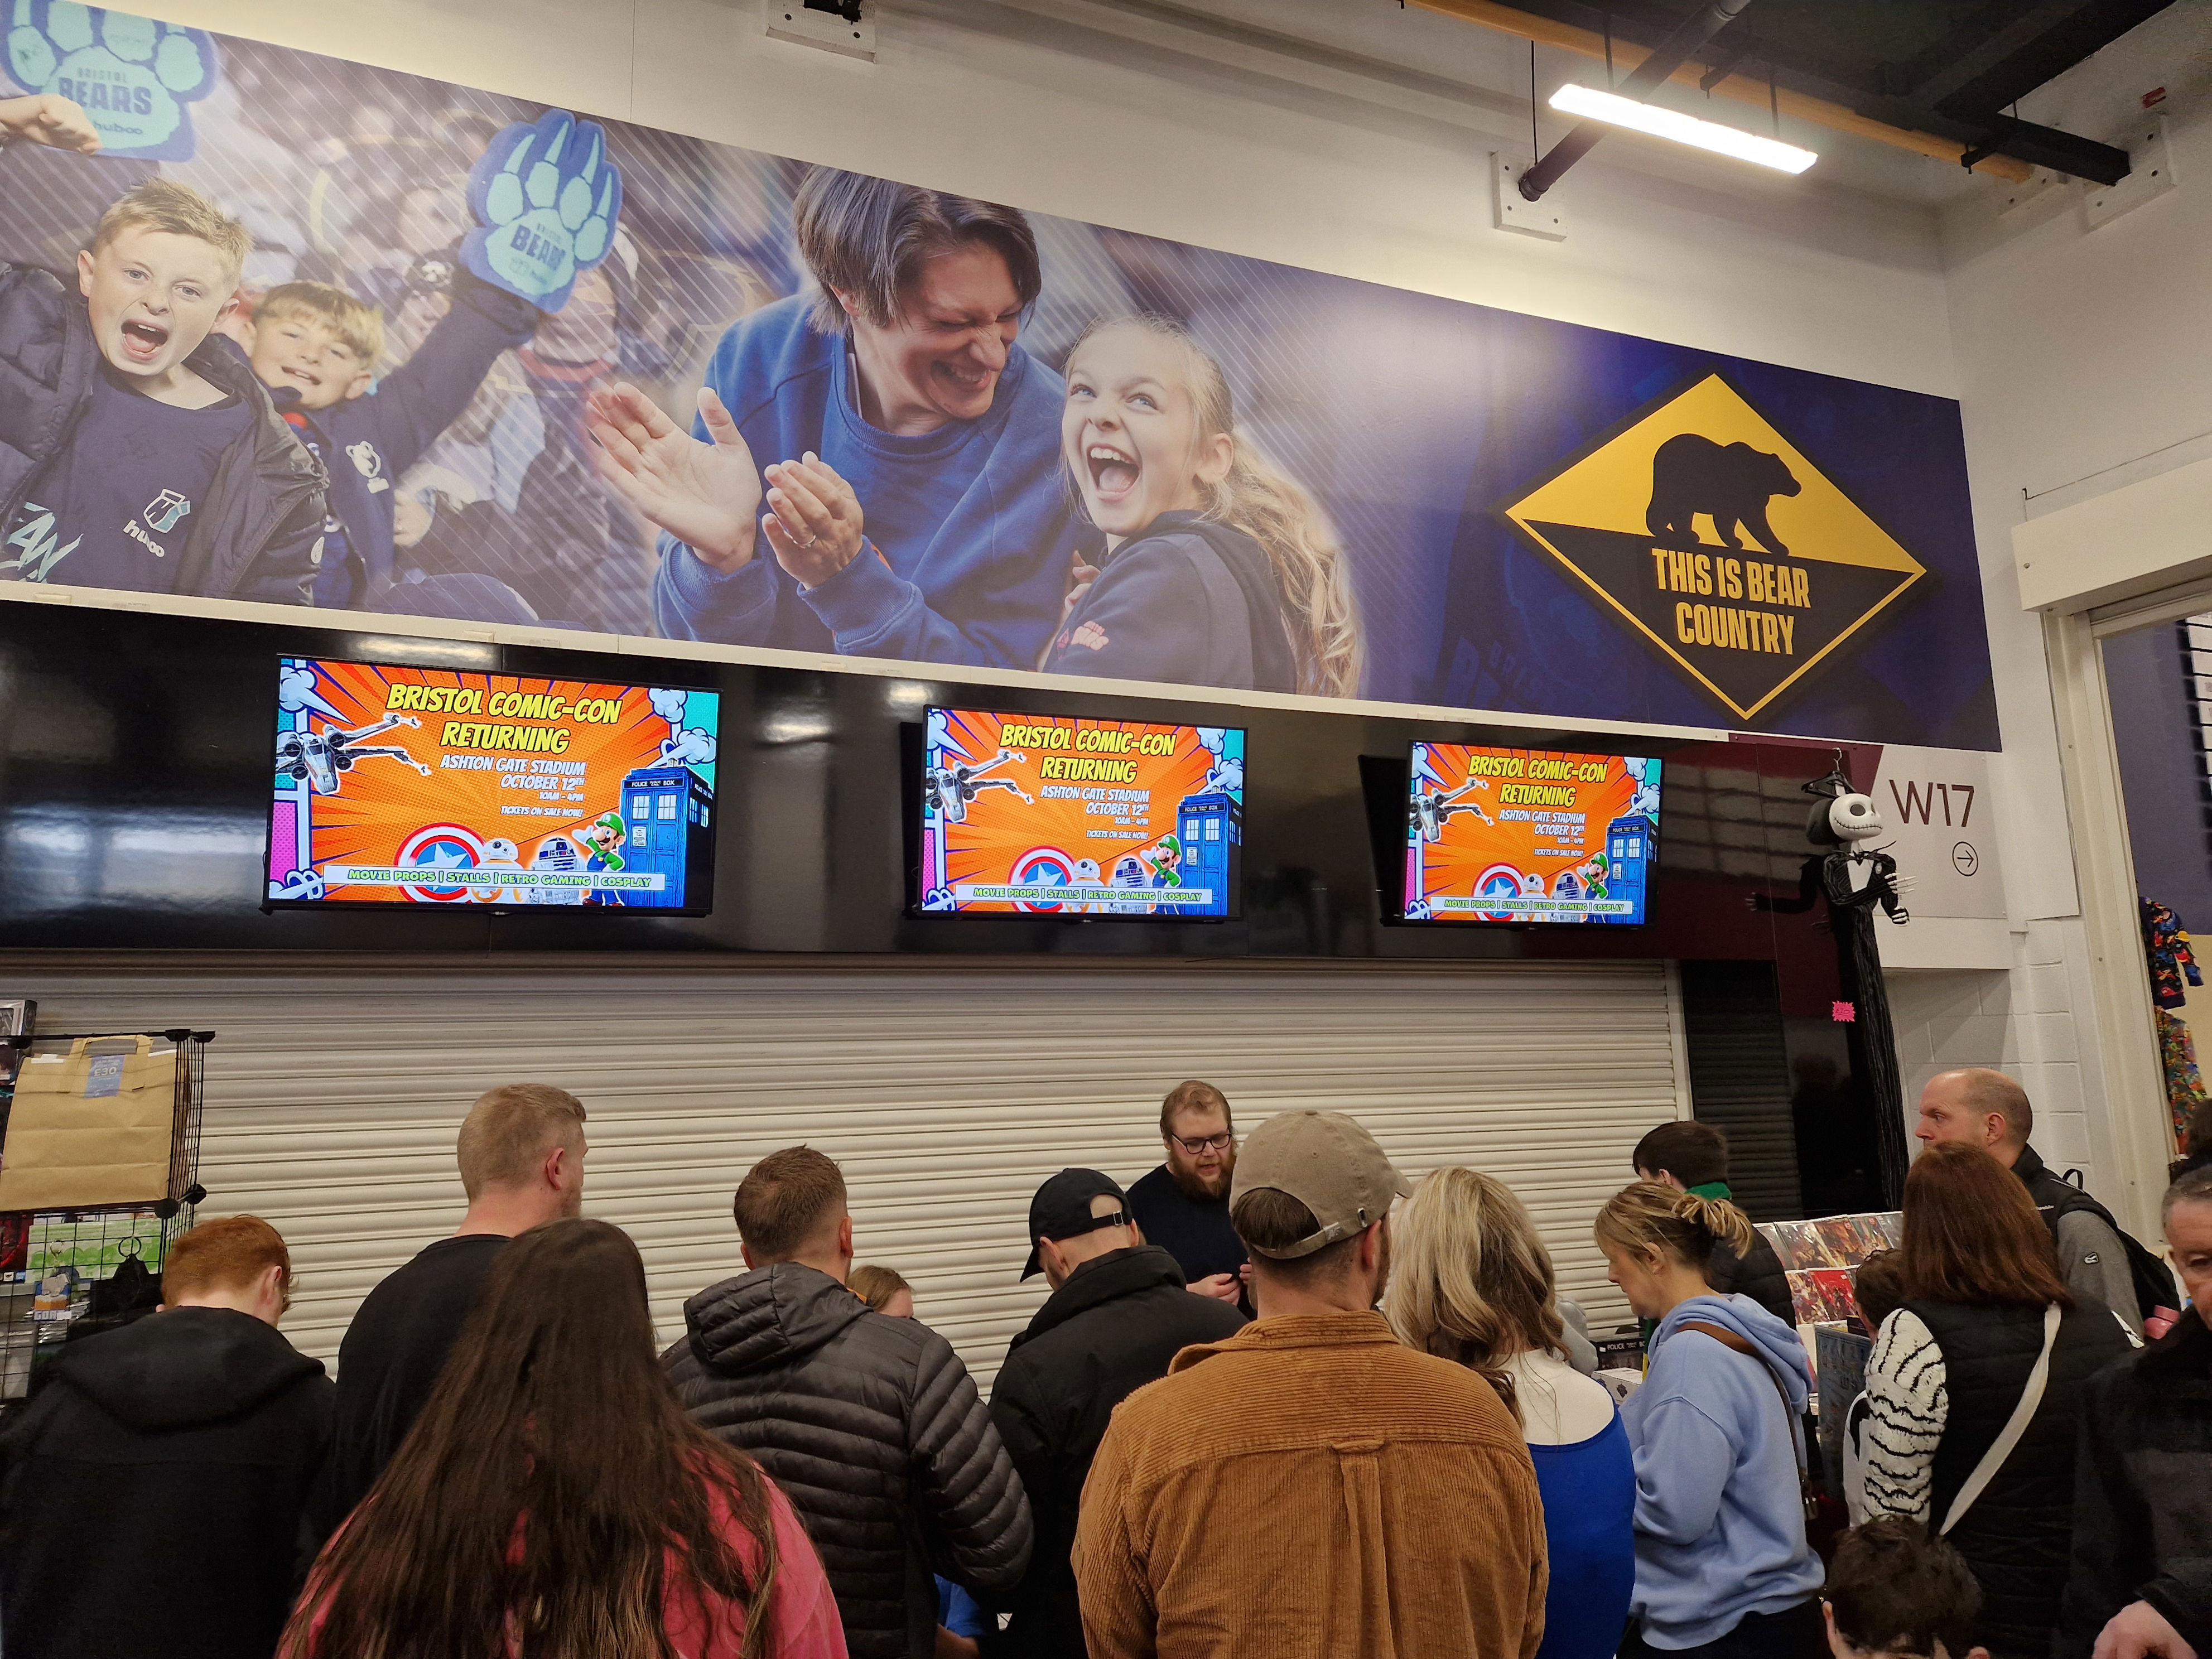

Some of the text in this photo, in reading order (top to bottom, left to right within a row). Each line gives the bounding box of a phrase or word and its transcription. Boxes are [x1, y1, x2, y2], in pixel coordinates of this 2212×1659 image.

[58, 76, 152, 115] BEARS
[1652, 548, 1811, 608] THIS IS BEAR
[1676, 602, 1795, 655] COUNTRY
[385, 683, 623, 724] BRISTOL COMIC-CON
[440, 721, 571, 754] RETURNING
[999, 724, 1177, 756] BRISTOL COMIC-CON
[439, 754, 586, 775] ASHTON GATE STADIUM
[1040, 756, 1138, 784] RETURNING
[1468, 755, 1608, 783] BRISTOL COMIC-CON
[500, 774, 585, 791] OCTOBER 12TH
[539, 791, 560, 800] 10AM
[567, 793, 584, 802] 4PM
[1040, 785, 1150, 803] ASHTON GATE STADIUM
[1498, 783, 1577, 807] RETURNING
[1890, 779, 1975, 827] W17
[500, 806, 584, 817] TICKETS ON SALE NOW!
[1086, 802, 1150, 816] OCTOBER 12TH
[1498, 809, 1585, 824] ASHTON GATE STADIUM
[1135, 817, 1149, 826] 4PM
[1534, 823, 1585, 836] OCTOBER 12TH
[1086, 830, 1149, 840] TICKETS ON SALE NOW!
[348, 869, 391, 880] MOVIE
[393, 870, 436, 882] PROPS
[446, 871, 490, 883] STALLS
[501, 874, 538, 884] RETRO
[541, 875, 591, 886] GAMING
[601, 876, 651, 887] COSPLAY
[974, 888, 1005, 897] MOVIE
[1008, 888, 1039, 898] PROPS
[1047, 889, 1080, 899] STALLS
[1088, 890, 1116, 899] RETRO
[1118, 891, 1156, 900] GAMING
[1163, 892, 1202, 901] COSPLAY
[1444, 899, 1469, 908] MOVIE
[1471, 900, 1496, 909] PROPS
[1502, 901, 1527, 909] STALLS
[1534, 901, 1556, 910] RETRO
[1558, 902, 1588, 910] GAMING
[1593, 903, 1625, 912] COSPLAY
